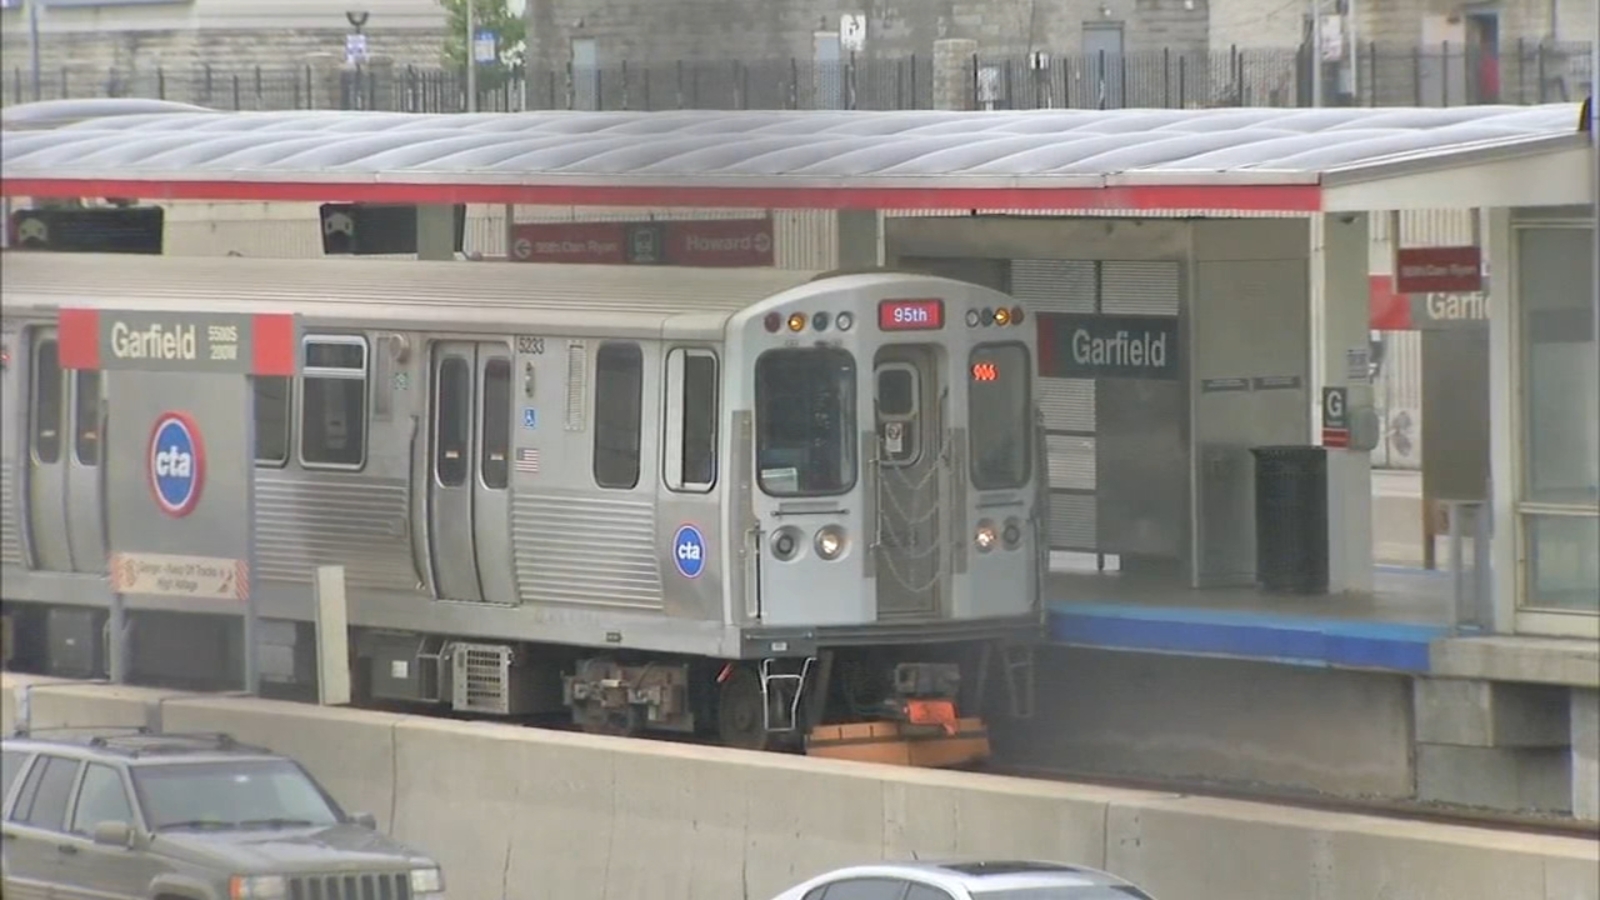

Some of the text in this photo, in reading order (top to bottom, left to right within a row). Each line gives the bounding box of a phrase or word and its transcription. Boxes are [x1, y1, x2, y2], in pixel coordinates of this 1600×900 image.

[686, 235, 751, 251] Howard
[893, 307, 928, 323] 95th
[110, 321, 197, 361] Garfield
[518, 337, 545, 355] 5233
[1071, 328, 1167, 367] Garfield
[1326, 389, 1343, 418] G
[156, 445, 191, 478] cta
[678, 541, 701, 560] cta
